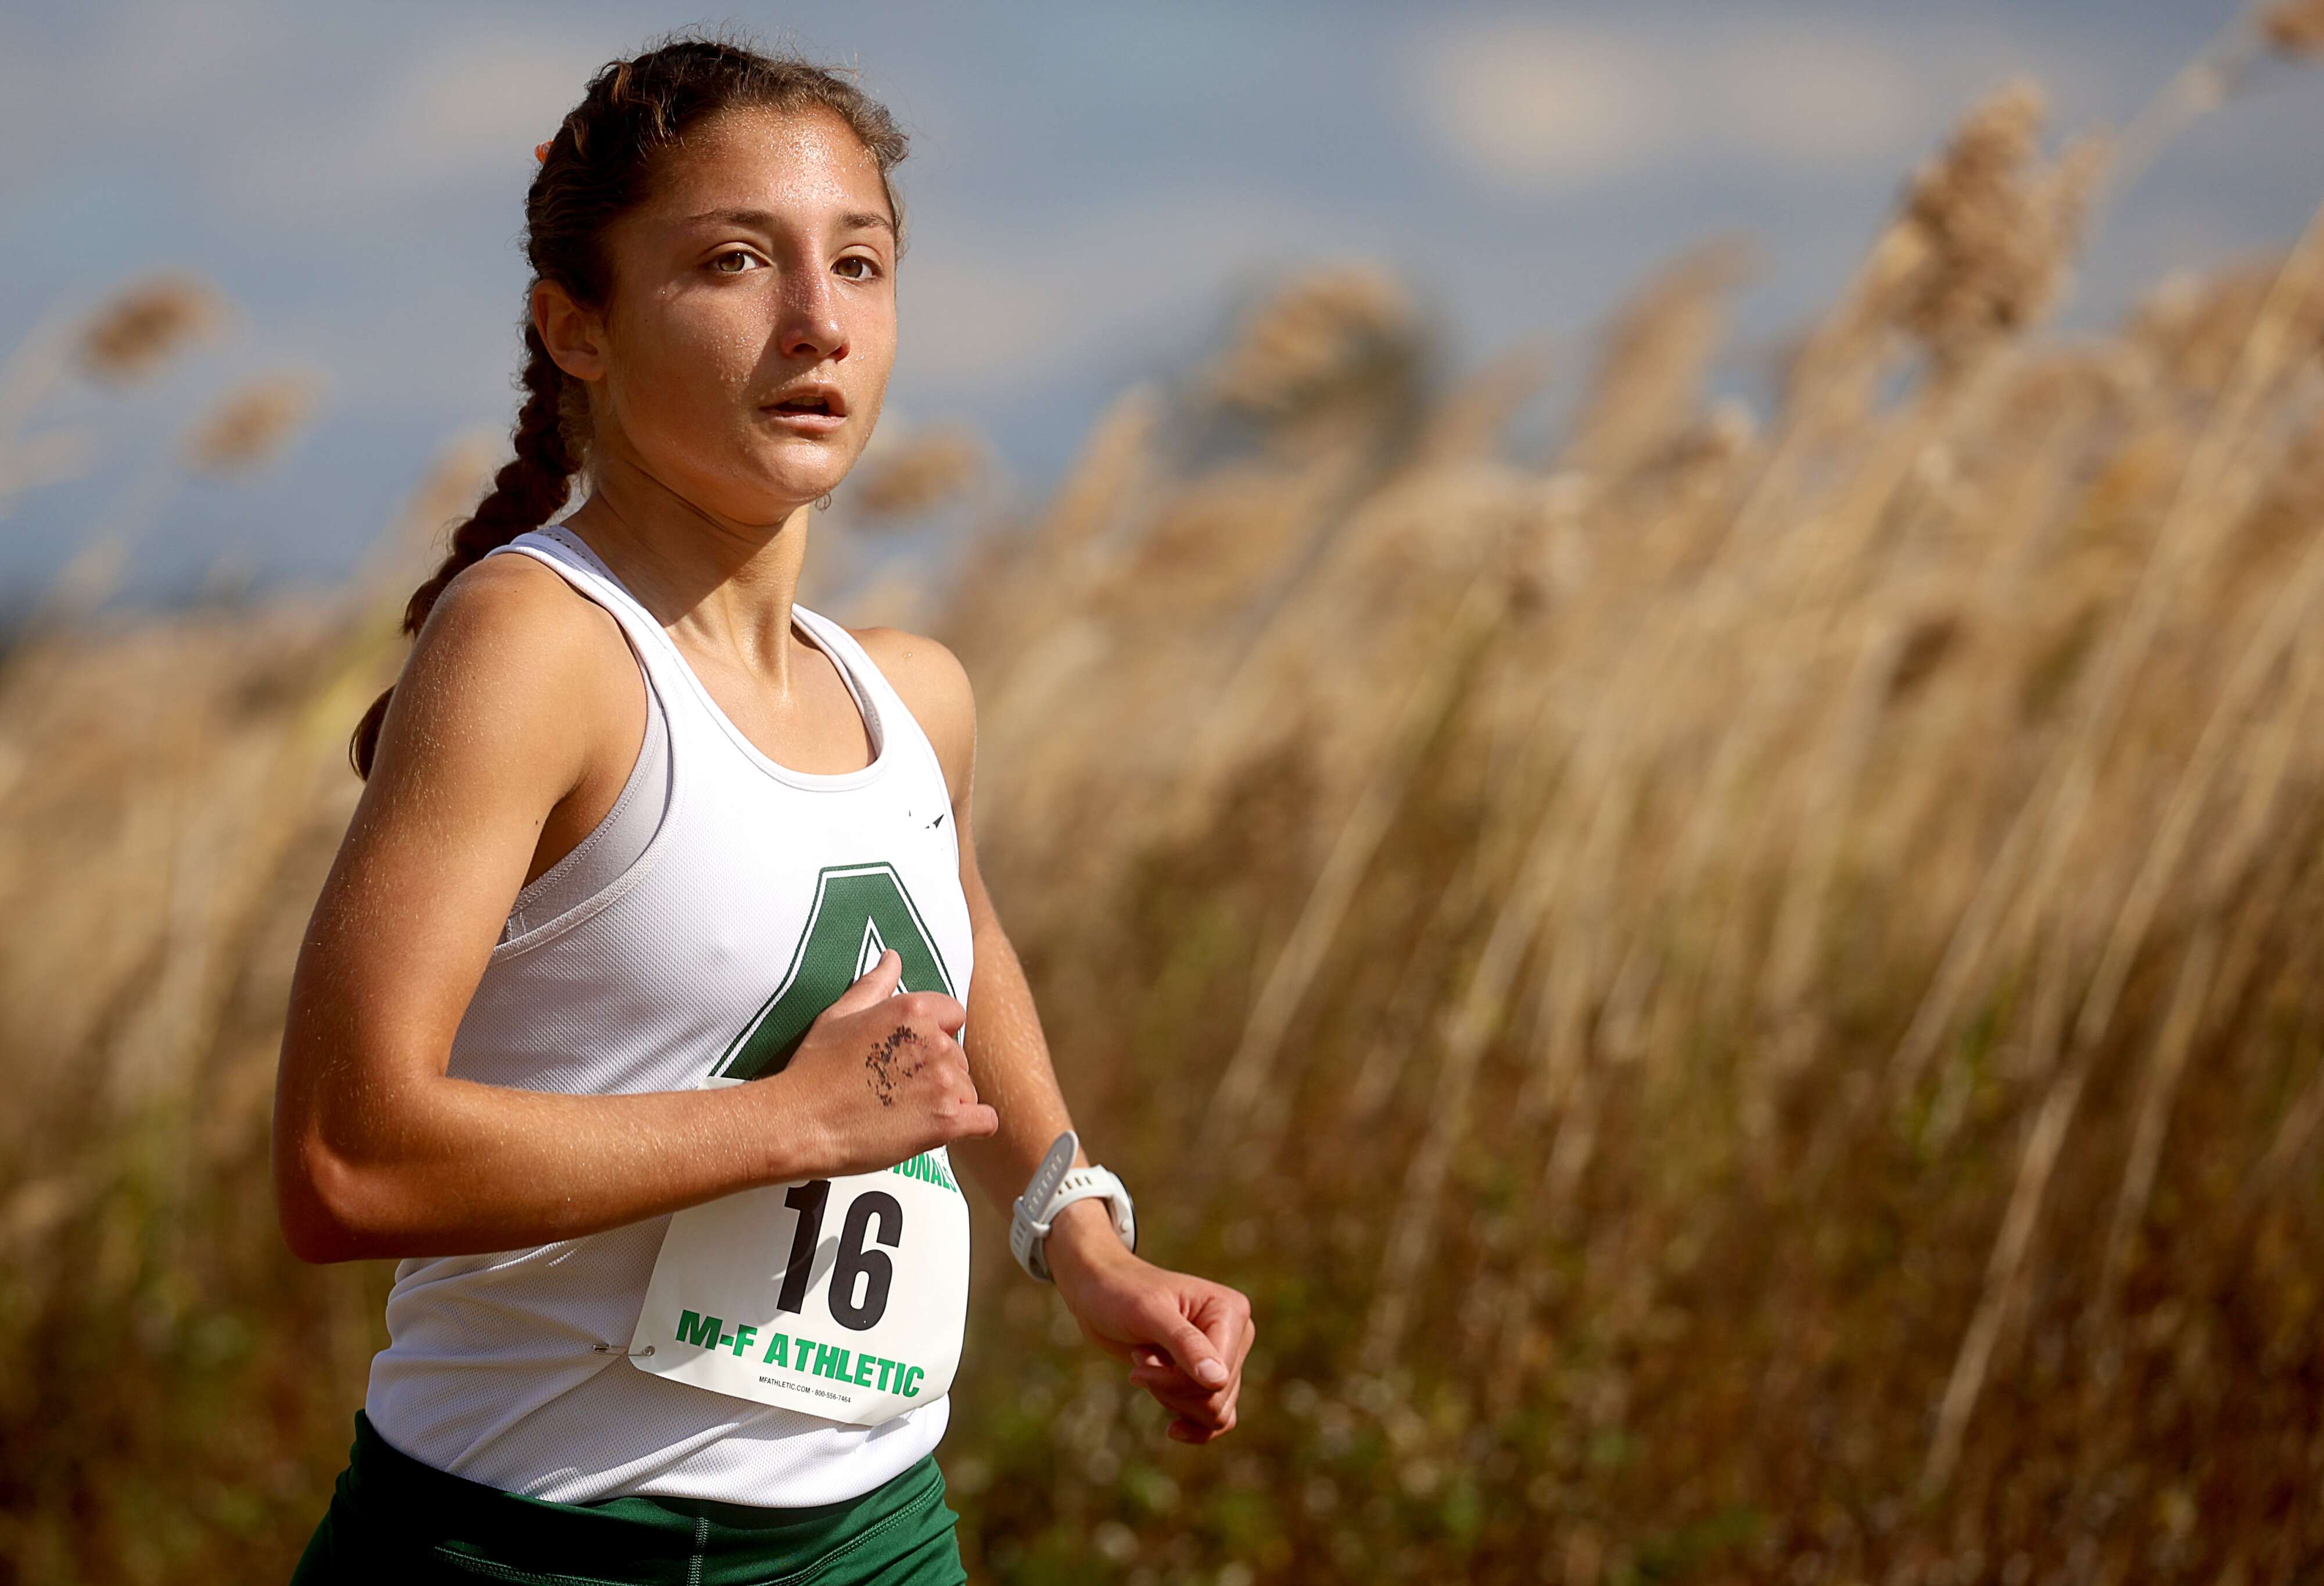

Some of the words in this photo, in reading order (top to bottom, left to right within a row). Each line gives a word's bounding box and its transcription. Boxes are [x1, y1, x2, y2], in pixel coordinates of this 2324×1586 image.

[777, 1180, 903, 1331] 16
[676, 1309, 758, 1357] M-F
[763, 1333, 924, 1398] ATHLETIC
[759, 1376, 810, 1394] MFATHLETIC.COM
[815, 1389, 851, 1404] 800-556-7464
